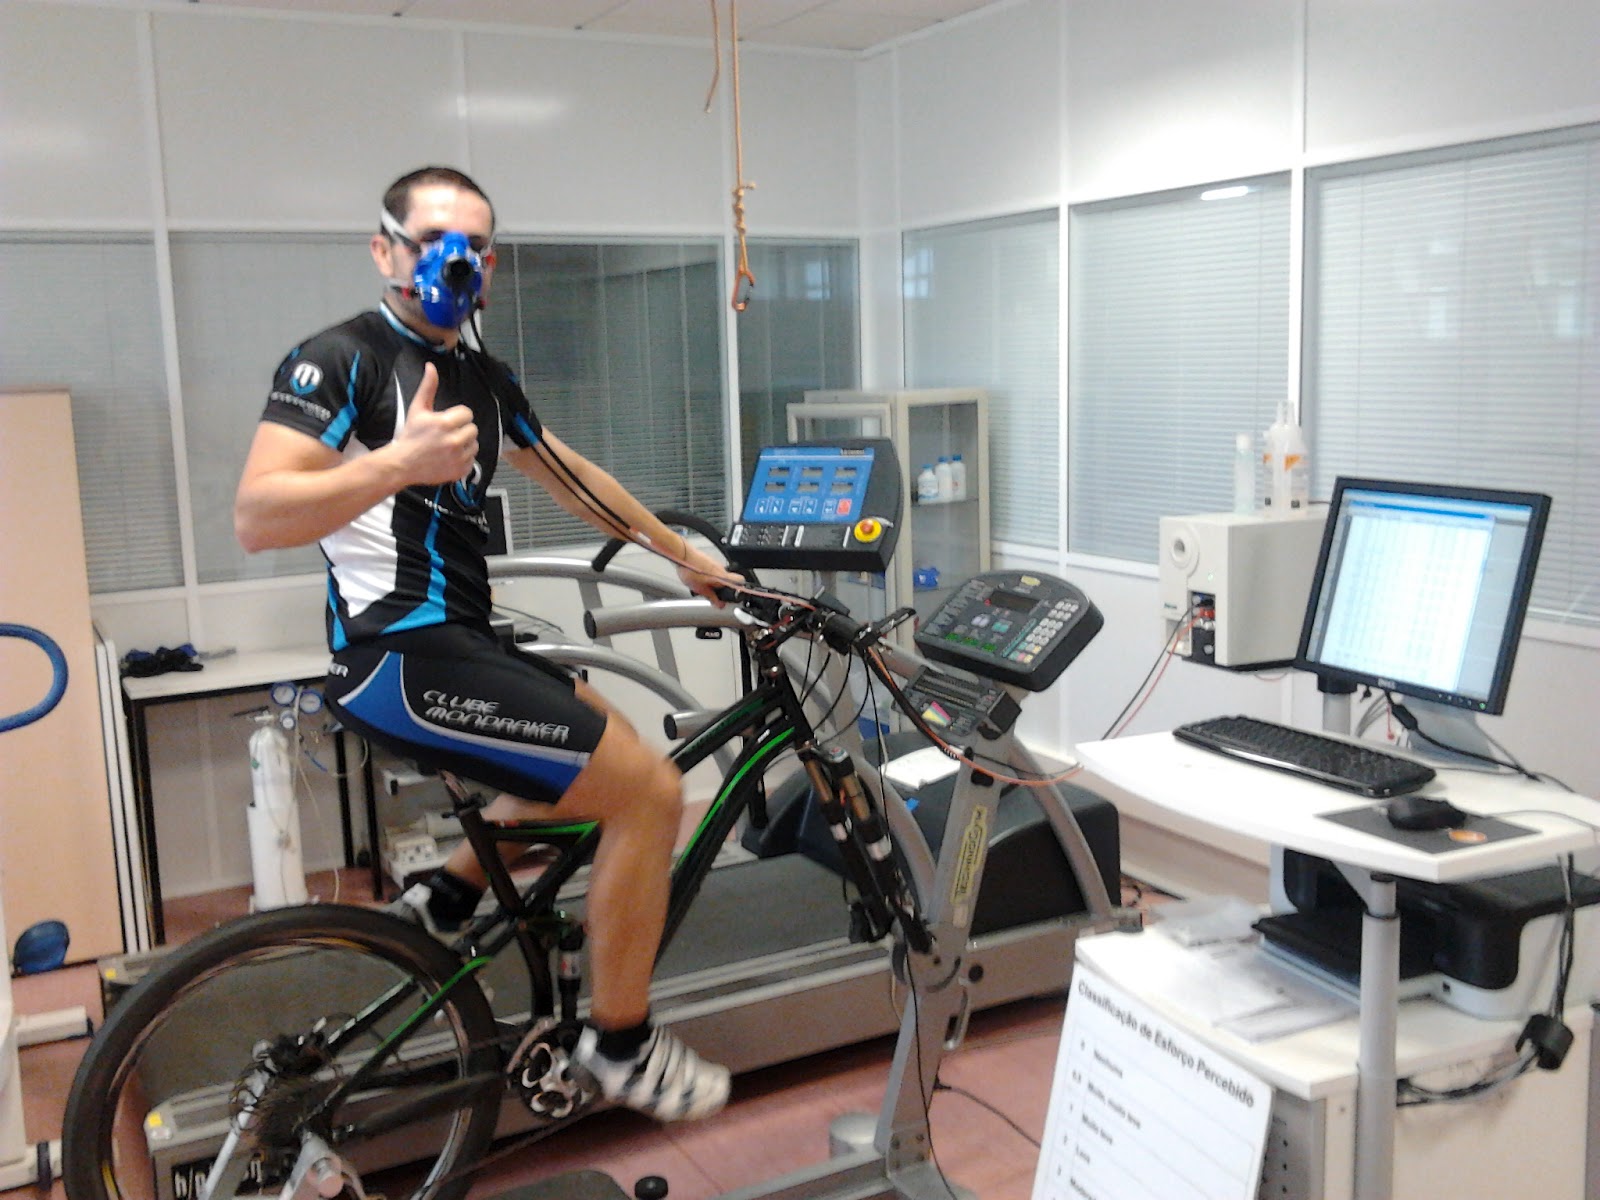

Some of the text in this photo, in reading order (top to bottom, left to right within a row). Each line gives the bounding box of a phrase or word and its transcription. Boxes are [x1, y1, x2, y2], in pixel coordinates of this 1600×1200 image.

[423, 689, 500, 715] CLUBE
[425, 706, 570, 744] MONDRAKER
[1078, 979, 1138, 1031] Classificação
[1139, 1023, 1153, 1040] de
[1154, 1029, 1195, 1070] Esforço
[1197, 1058, 1255, 1109] Percebido
